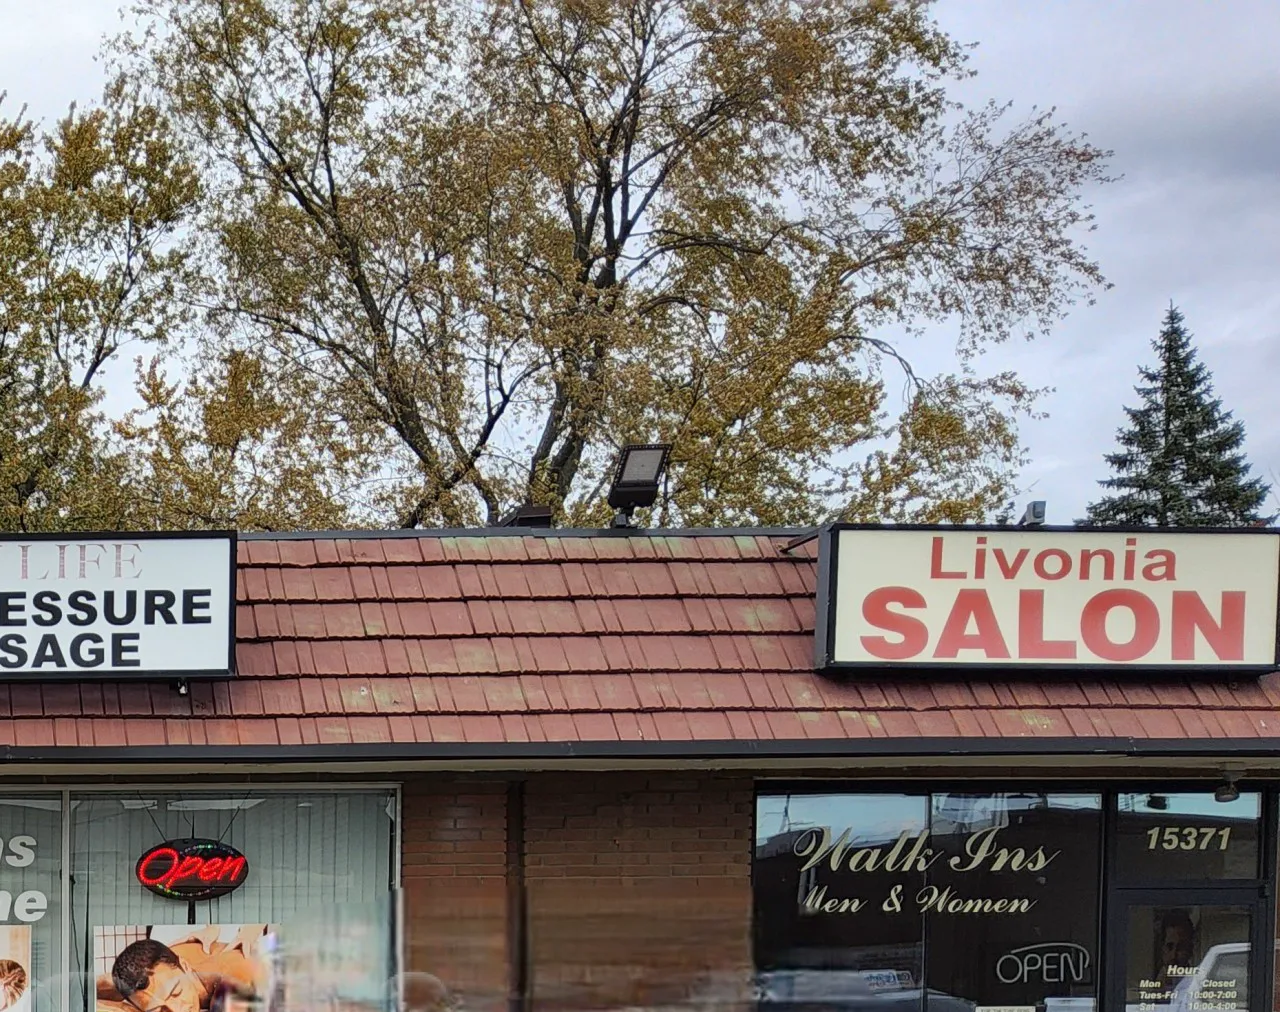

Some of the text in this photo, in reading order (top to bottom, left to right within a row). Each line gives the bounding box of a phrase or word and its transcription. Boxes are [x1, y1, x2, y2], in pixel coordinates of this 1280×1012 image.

[19, 543, 143, 580] LIFE
[930, 536, 1177, 581] Livonia
[860, 586, 1247, 661] SALON
[794, 825, 1061, 872] Walk Ins
[1147, 827, 1231, 850] 15371
[138, 846, 247, 885] Open
[802, 884, 1038, 913] Men & Women
[996, 952, 1083, 983] OPEN
[1139, 990, 1237, 999] Tues-Fri 10:00-7:00
[1140, 979, 1236, 988] Mon Closed
[1139, 1002, 1237, 1011] Sat 10:00-4:00
